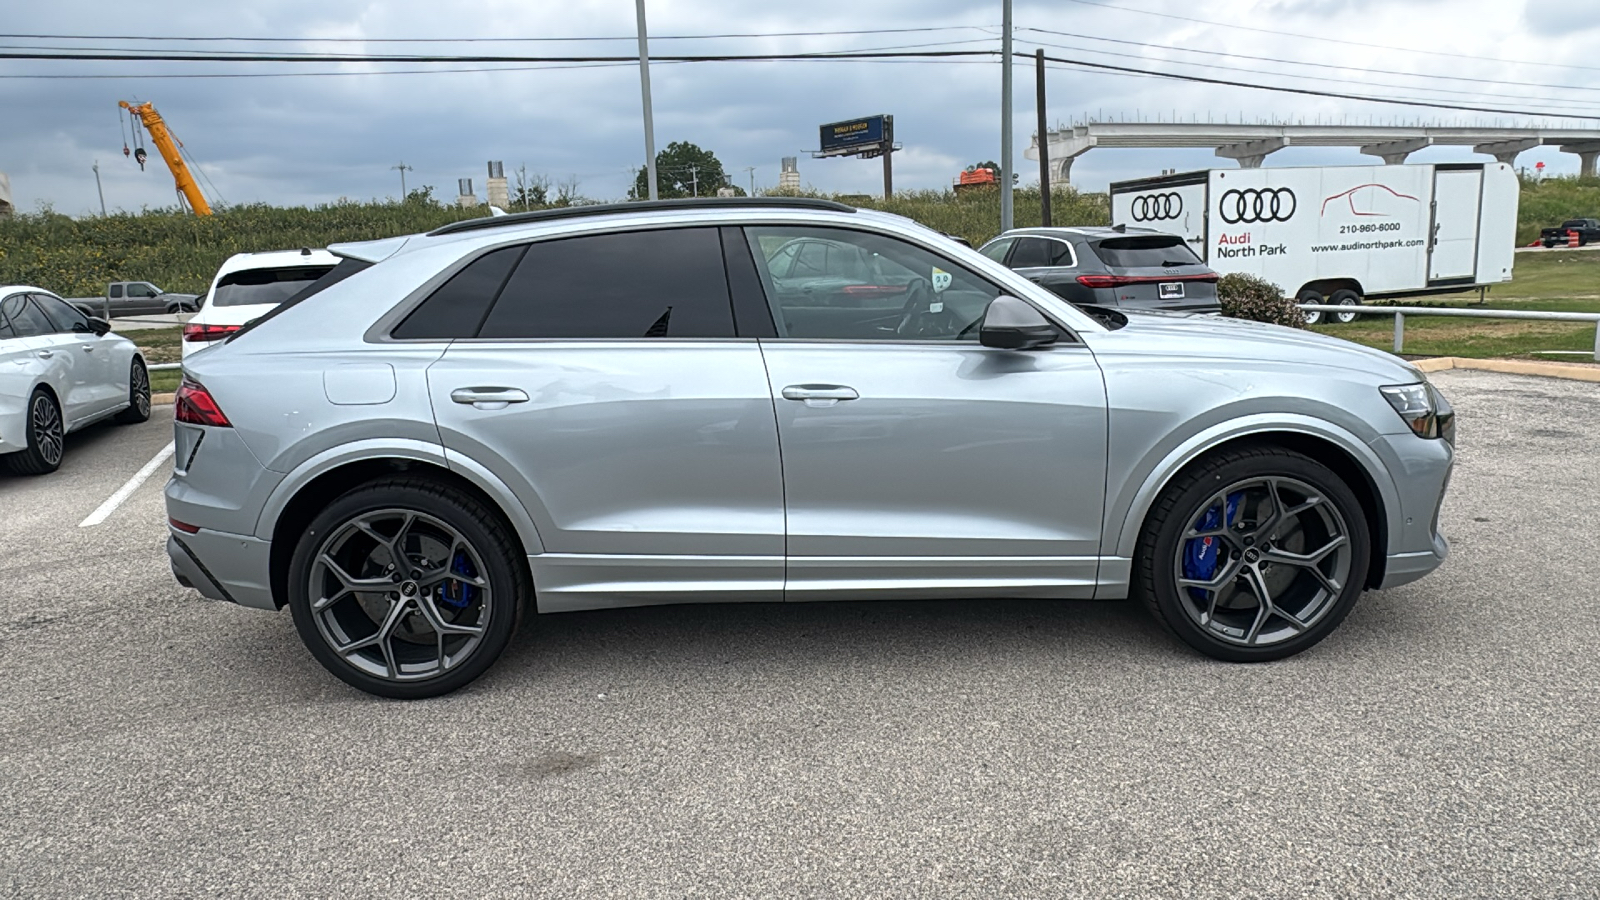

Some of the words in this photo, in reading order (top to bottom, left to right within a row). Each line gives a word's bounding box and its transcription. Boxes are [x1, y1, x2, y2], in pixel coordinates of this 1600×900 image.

[1339, 222, 1401, 234] 210-960-6000
[1218, 232, 1251, 245] Audi
[1217, 245, 1256, 258] North
[1259, 243, 1287, 256] Park
[1311, 239, 1424, 252] www.audinorthpark.com
